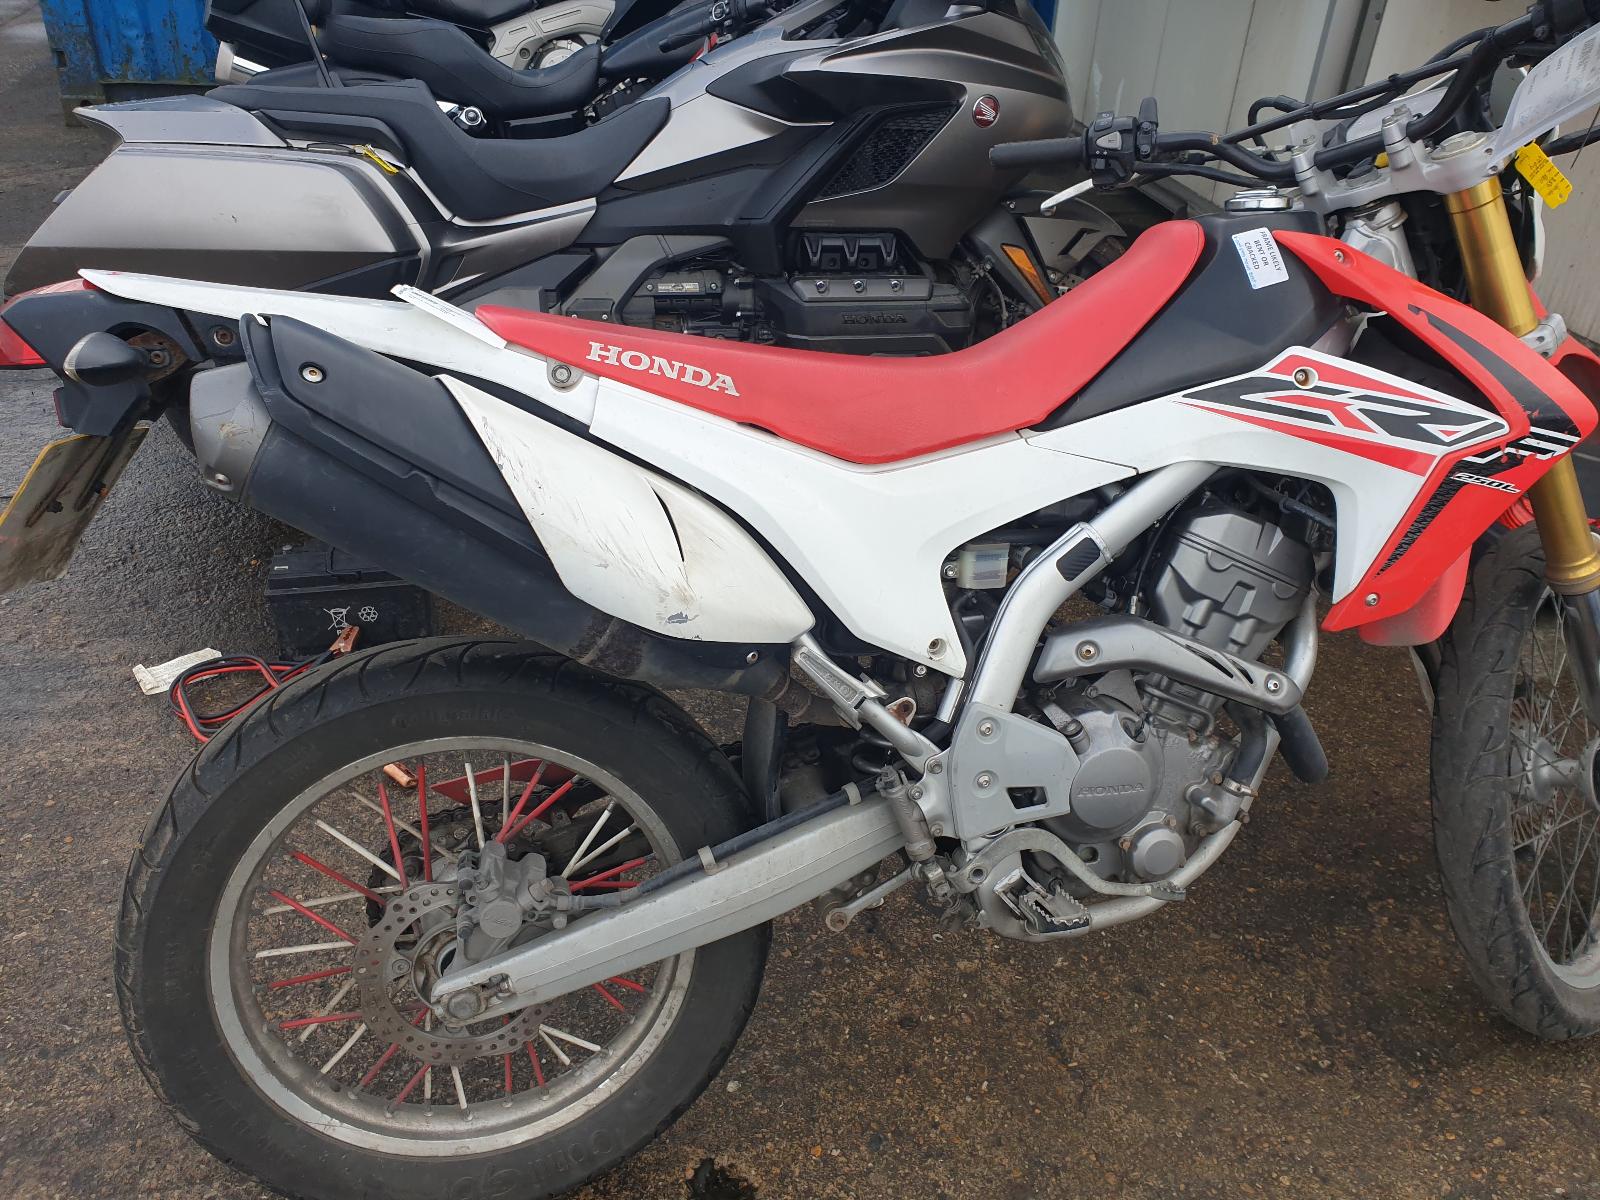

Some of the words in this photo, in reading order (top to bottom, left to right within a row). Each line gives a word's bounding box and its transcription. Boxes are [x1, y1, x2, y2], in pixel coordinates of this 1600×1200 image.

[1244, 242, 1260, 270] CRACKED
[1253, 239, 1266, 255] BENT
[1261, 256, 1270, 267] OR
[1260, 231, 1273, 251] FRAME
[1269, 252, 1282, 271] LIKELY
[841, 312, 907, 325] HONDA
[586, 341, 740, 397] HONDA
[1450, 472, 1521, 494] 250L
[1077, 783, 1145, 797] HONDA
